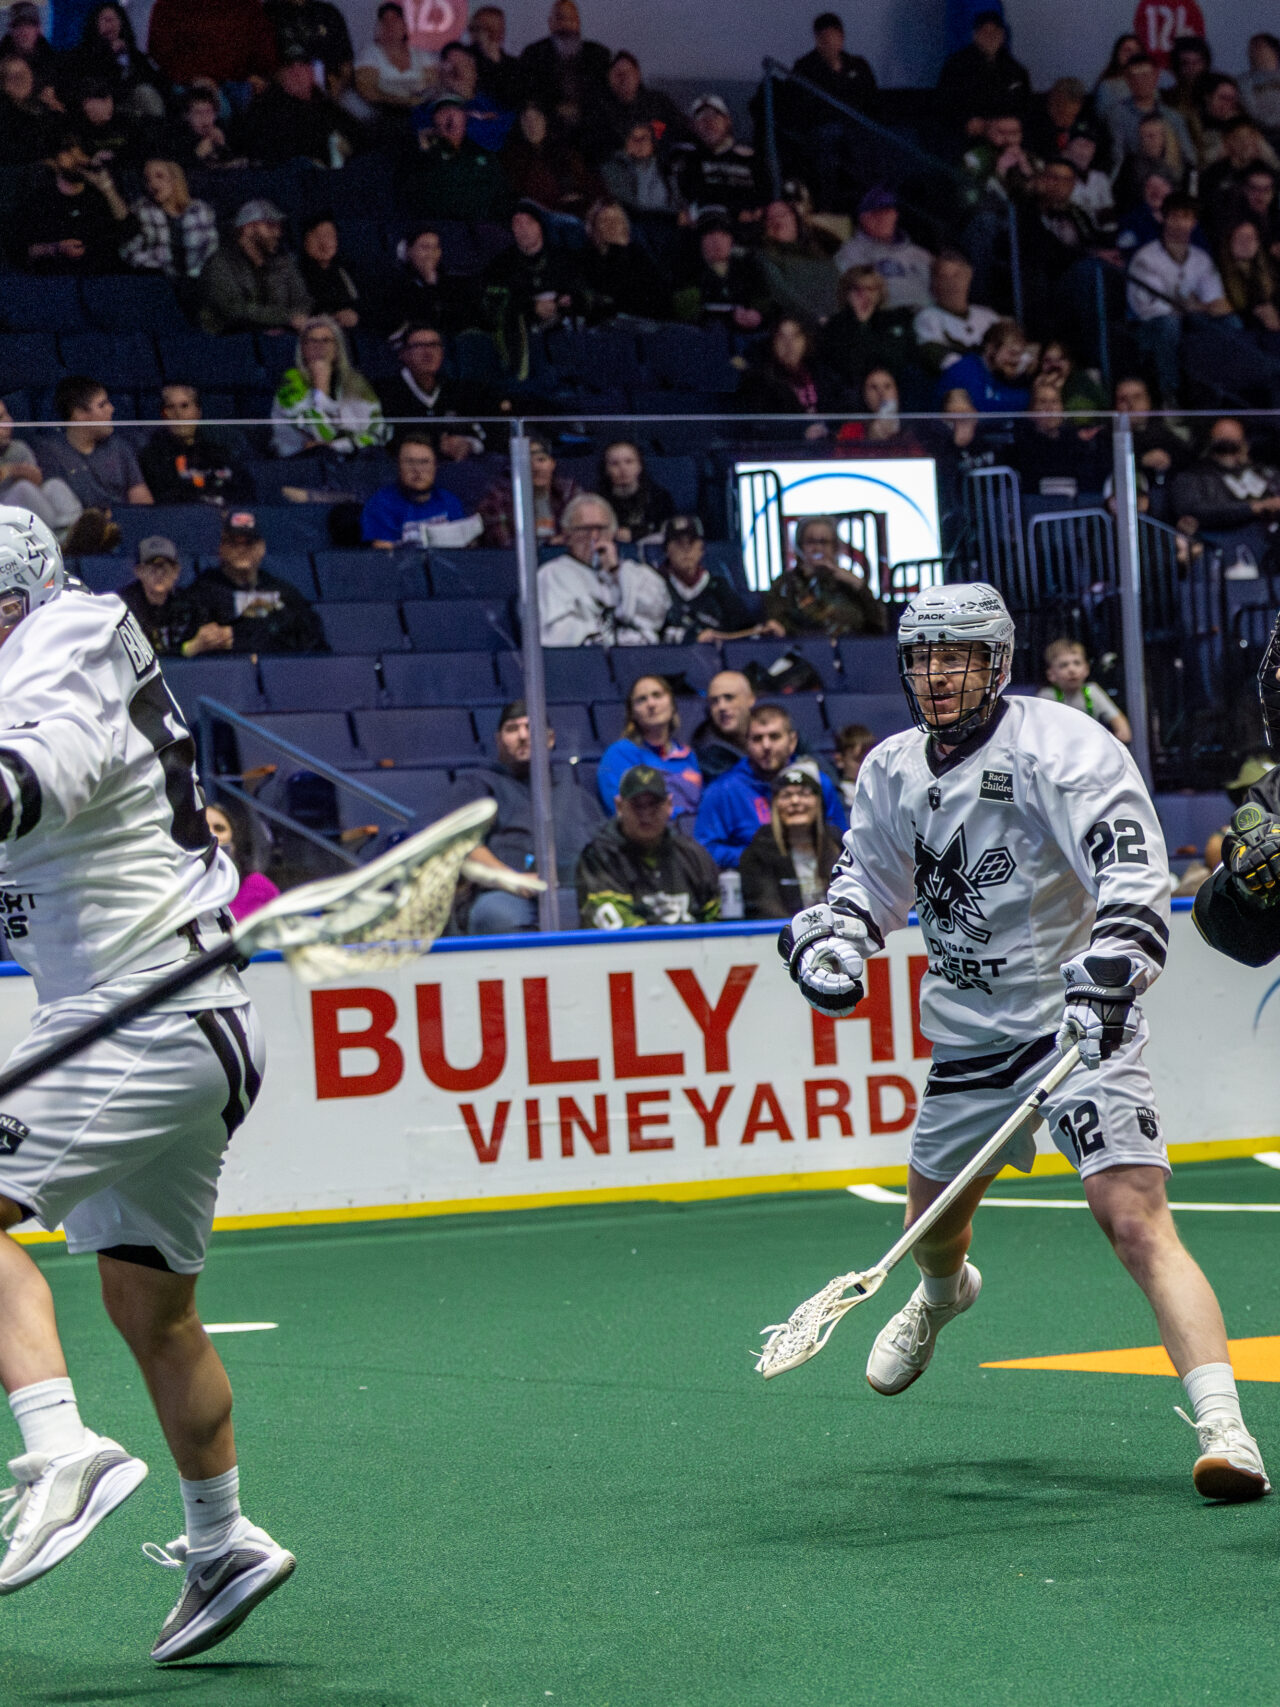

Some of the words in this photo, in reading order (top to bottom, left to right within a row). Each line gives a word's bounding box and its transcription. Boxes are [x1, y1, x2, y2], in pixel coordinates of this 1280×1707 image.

[918, 613, 946, 621] PACK
[981, 781, 1013, 793] Childre
[988, 772, 1009, 785] Rady
[1084, 818, 1149, 877] 22
[310, 965, 759, 1101] BULLY
[458, 1074, 917, 1164] VINEYARD
